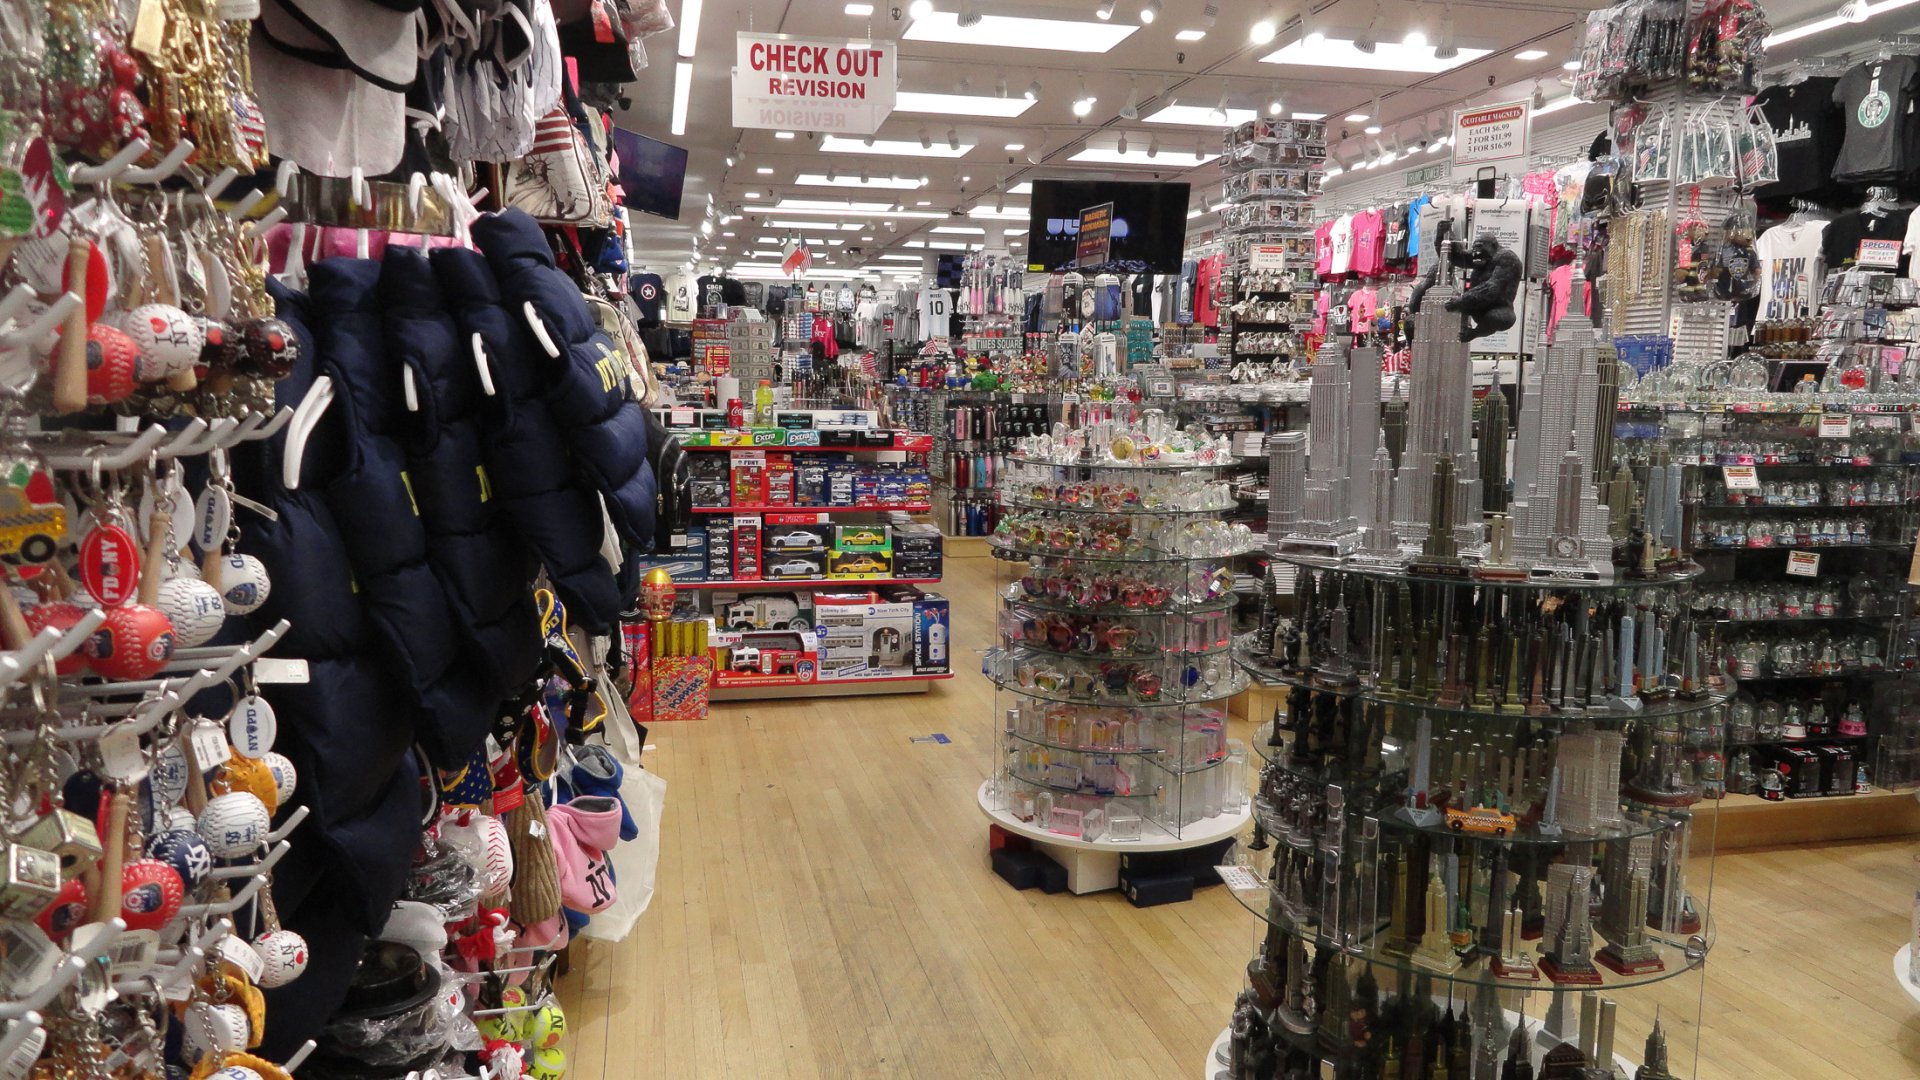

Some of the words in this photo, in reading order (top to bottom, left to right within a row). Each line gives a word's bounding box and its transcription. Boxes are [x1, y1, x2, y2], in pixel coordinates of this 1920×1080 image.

[750, 43, 828, 74] CHECK
[837, 47, 883, 77] OUT
[769, 77, 865, 99] REVISION
[1462, 114, 1491, 126] QUOTABLE
[1491, 109, 1521, 120] MAGNETS
[1469, 127, 1491, 136] EACH
[1492, 123, 1510, 132] $6.99
[1474, 136, 1490, 144] FOR
[1491, 132, 1512, 141] $11.99
[1467, 145, 1472, 153] 3
[1474, 144, 1489, 153] FOR
[1490, 141, 1512, 151] $16.99
[929, 300, 944, 316] 10
[976, 338, 996, 350] TIMES
[997, 338, 1023, 349] SQUARE
[763, 406, 771, 416] G
[755, 433, 776, 443] Extra
[789, 432, 811, 443] Extra
[1443, 568, 1460, 576] STATE
[661, 677, 688, 701] PARTY
[668, 678, 704, 709] POPPERS
